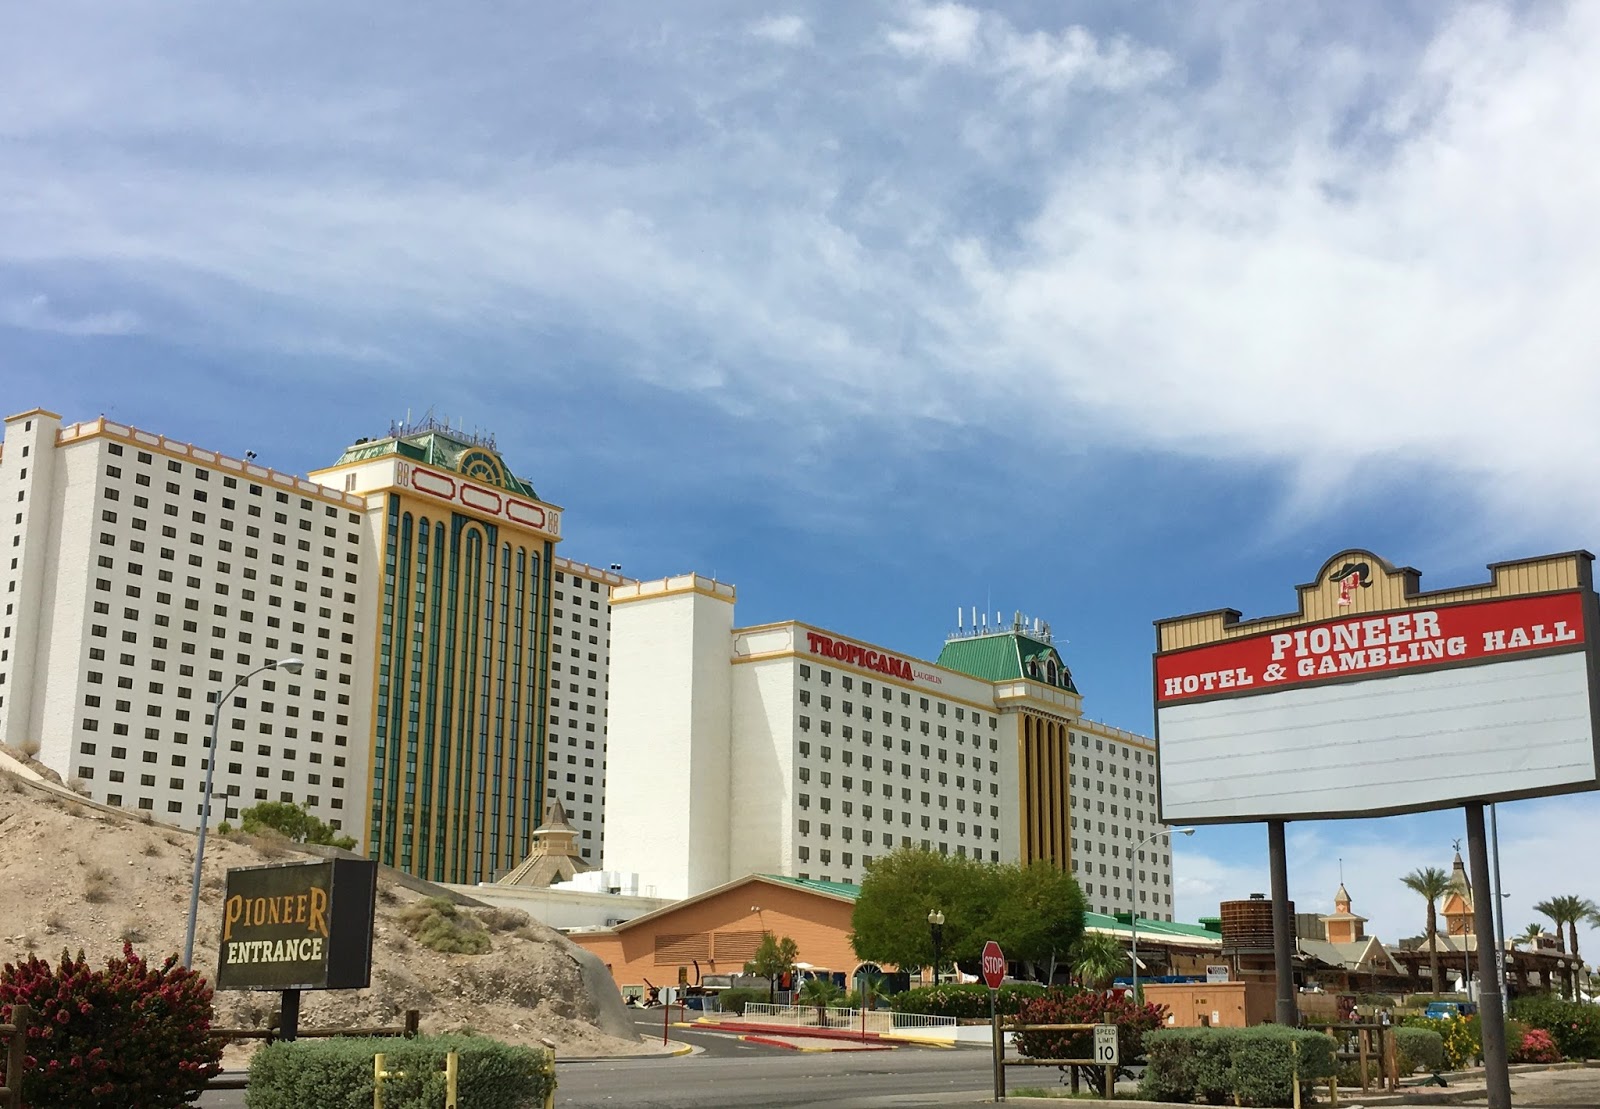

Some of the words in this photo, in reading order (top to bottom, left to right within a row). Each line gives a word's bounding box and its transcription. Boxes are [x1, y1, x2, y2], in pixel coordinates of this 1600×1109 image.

[807, 632, 915, 681] TROPICANA
[914, 671, 942, 684] LAUGHLIN
[1164, 667, 1253, 697] HOTEL
[1263, 663, 1287, 683] &
[1297, 636, 1467, 677] GAMBLING
[1482, 621, 1576, 652] HALL
[1270, 611, 1441, 661] PIONEER
[223, 887, 328, 941] PIONEER
[227, 938, 322, 964] ENTRANCE
[984, 956, 1003, 974] STOP
[1098, 1046, 1114, 1061] 10
